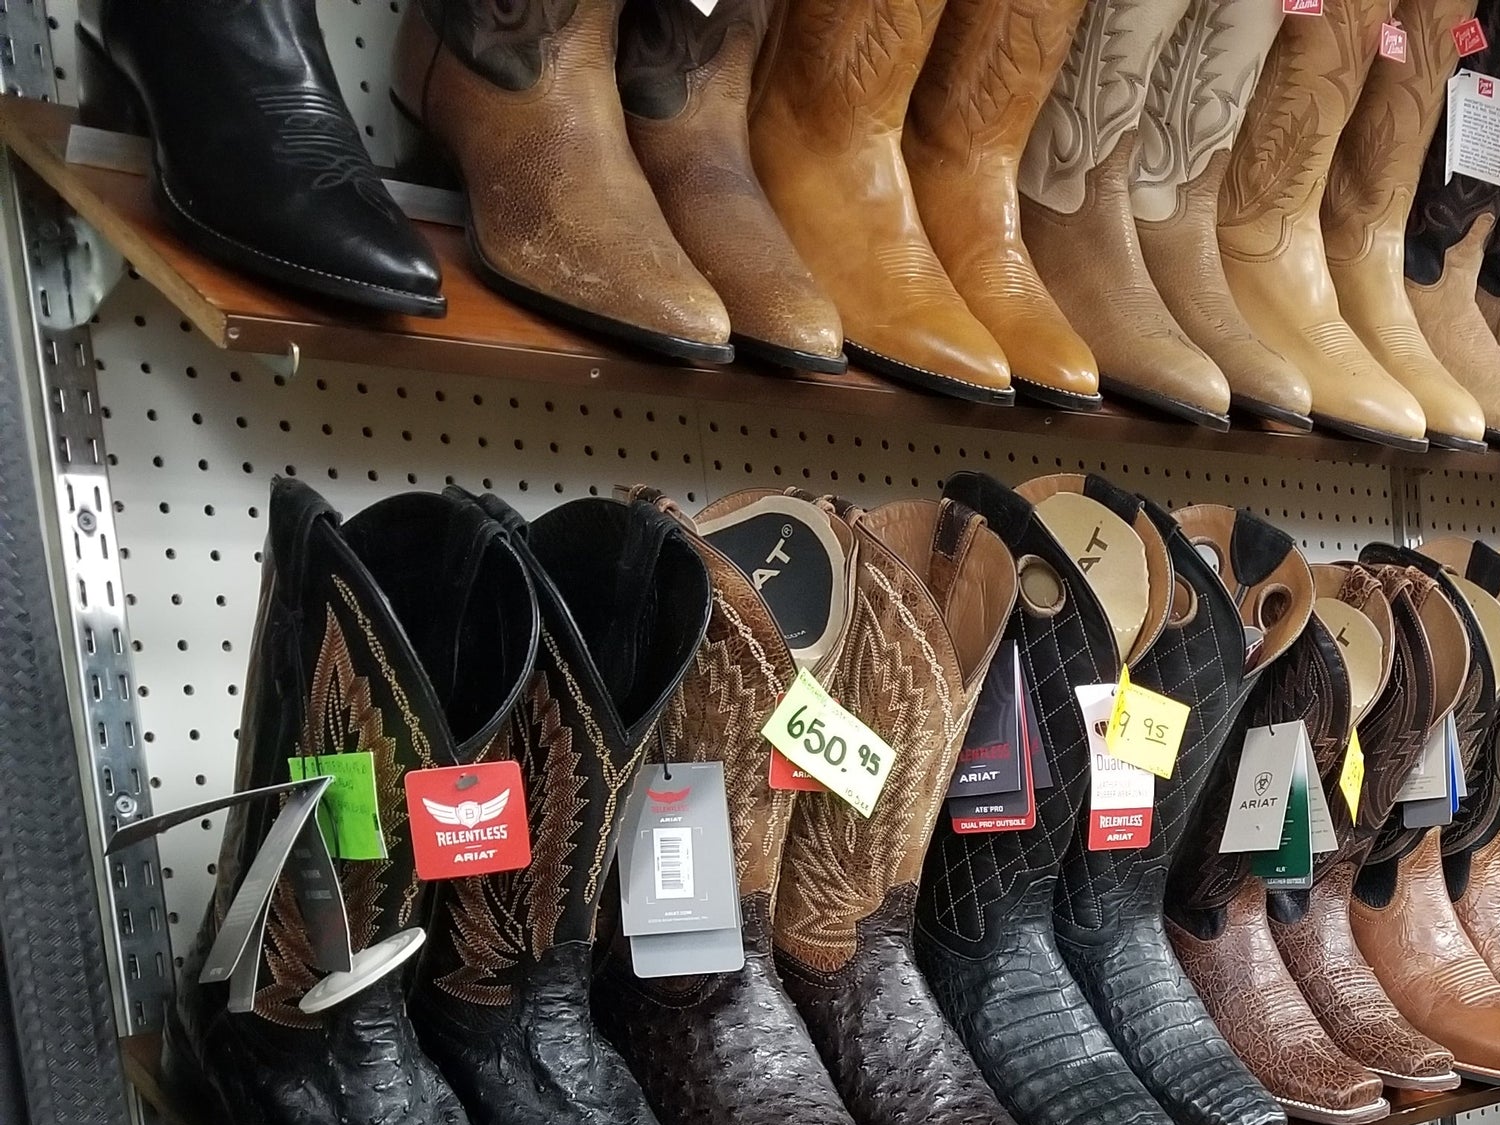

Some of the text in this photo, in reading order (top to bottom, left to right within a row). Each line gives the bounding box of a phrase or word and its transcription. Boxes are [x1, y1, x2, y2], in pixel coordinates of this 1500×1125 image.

[959, 770, 1001, 784] ARIAT
[989, 805, 1004, 813] PRO
[1239, 797, 1278, 810] ARIAT
[659, 816, 683, 824] ARIAT
[960, 821, 978, 830] DUAL
[995, 818, 1027, 828] OUTSOLE
[1099, 814, 1143, 829] RELENTLESS
[435, 824, 509, 847] RELENTLESS
[1106, 832, 1134, 842] ARIAT
[453, 849, 498, 864] ARIAT
